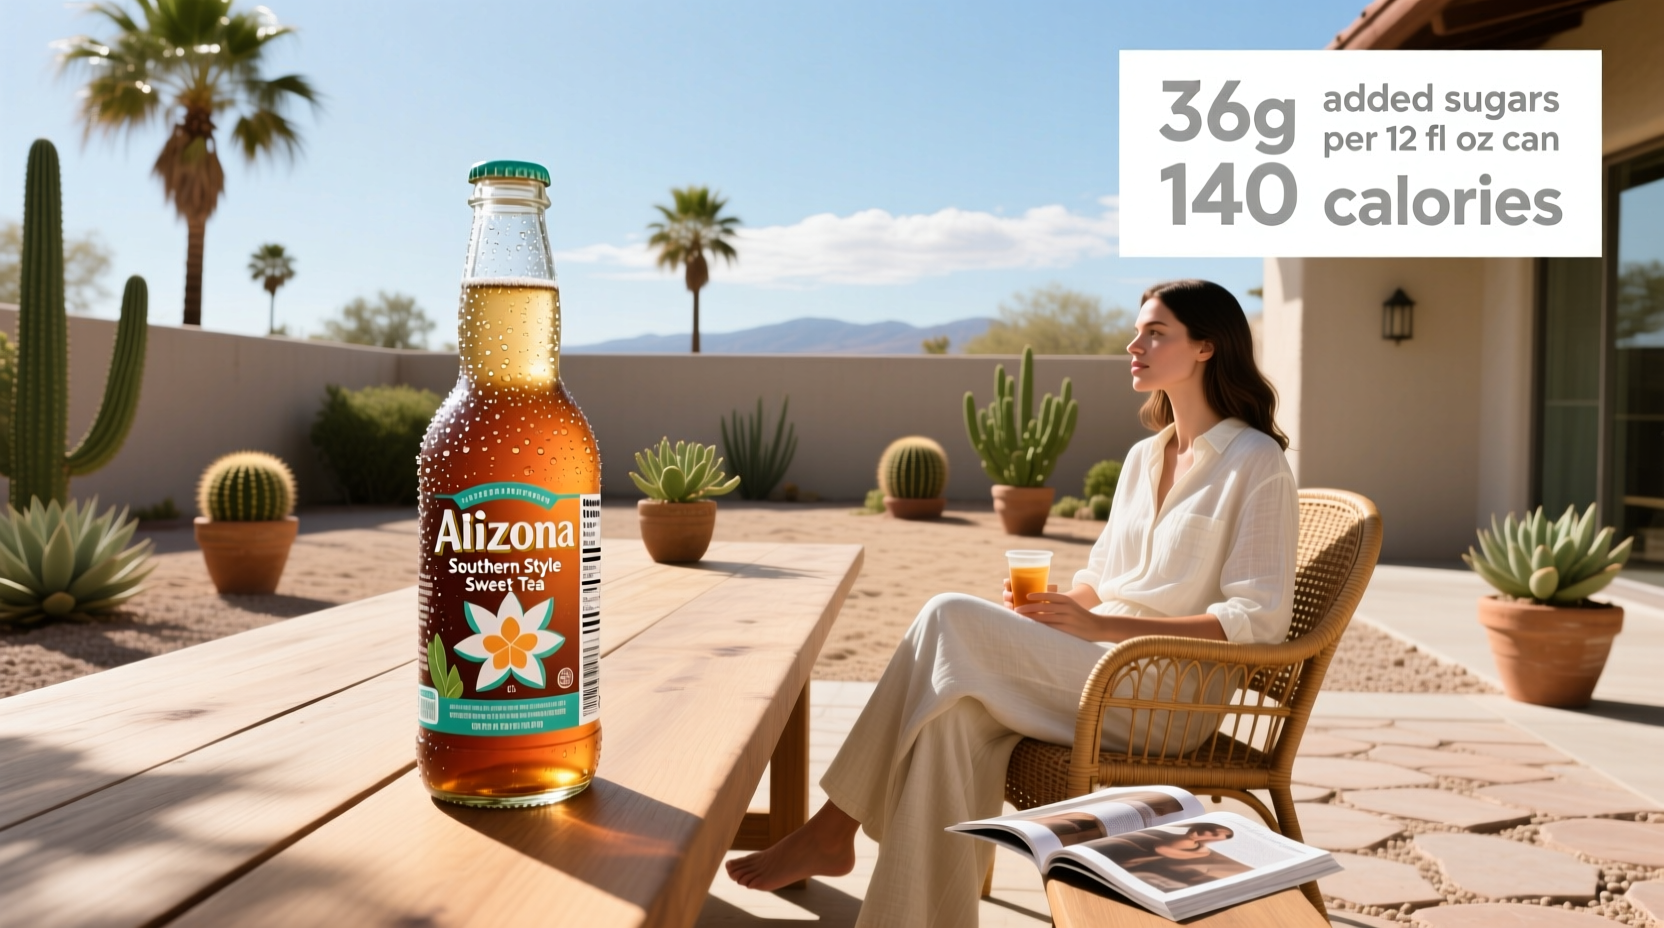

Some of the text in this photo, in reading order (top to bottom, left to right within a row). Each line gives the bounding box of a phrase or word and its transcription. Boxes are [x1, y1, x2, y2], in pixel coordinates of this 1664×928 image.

[434, 509, 576, 555] Alizona
[448, 557, 520, 575] Southern
[524, 557, 562, 577] Style
[465, 576, 545, 592] Sweet Tea
